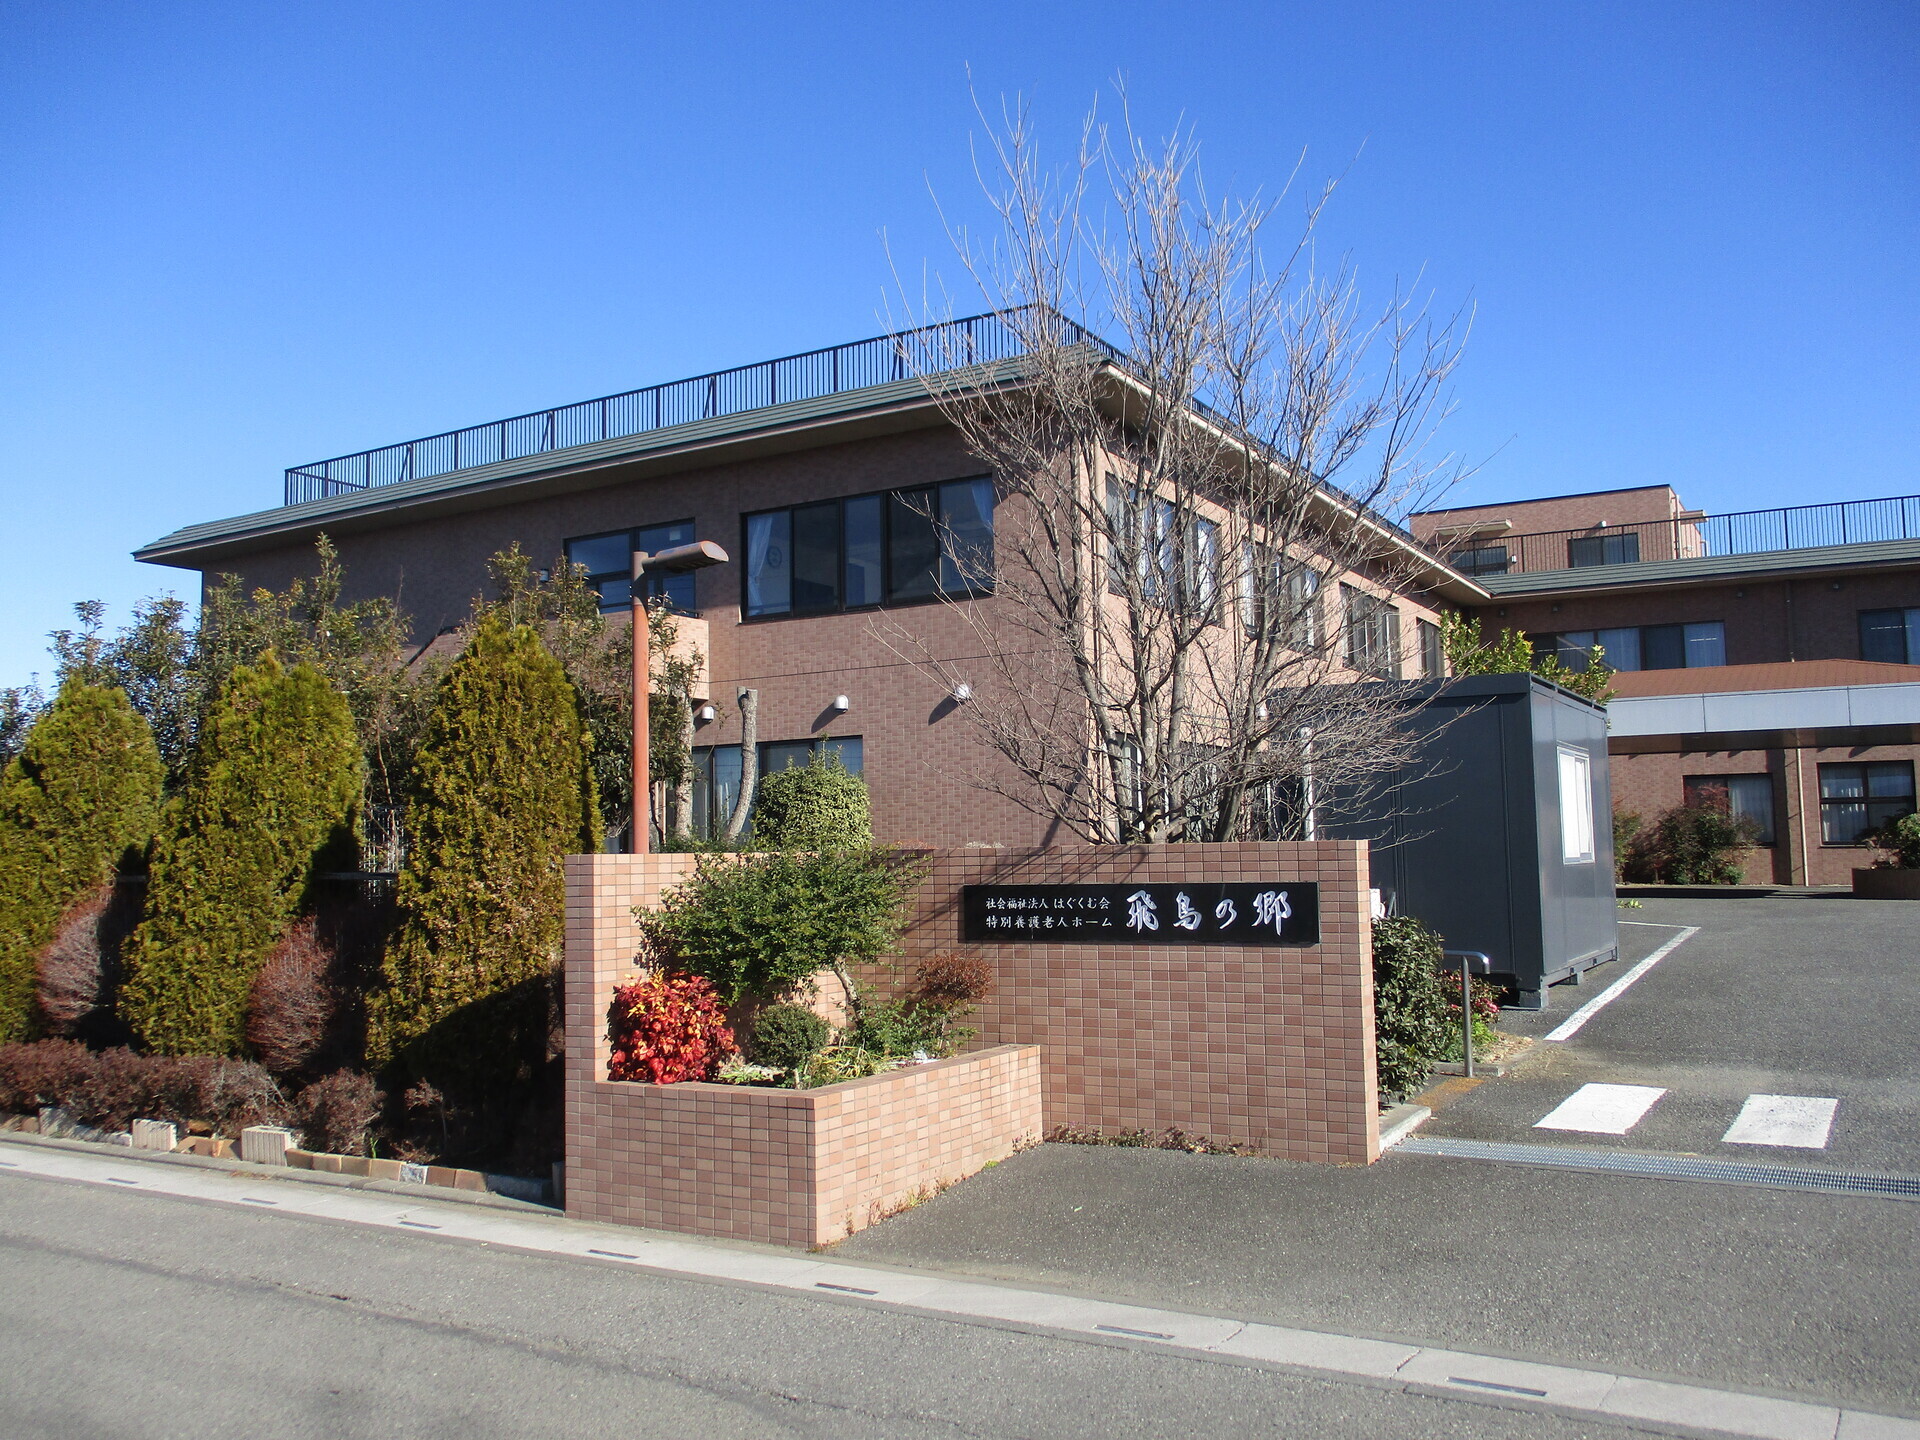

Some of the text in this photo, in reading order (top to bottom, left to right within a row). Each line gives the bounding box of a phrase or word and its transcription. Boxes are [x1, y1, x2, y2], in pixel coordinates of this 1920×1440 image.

[985, 897, 1111, 910] 社会福祉法人 はぐくむ会
[1125, 889, 1292, 936] 飛鳥の郷
[985, 914, 1113, 929] 特別養護老人ホーム
